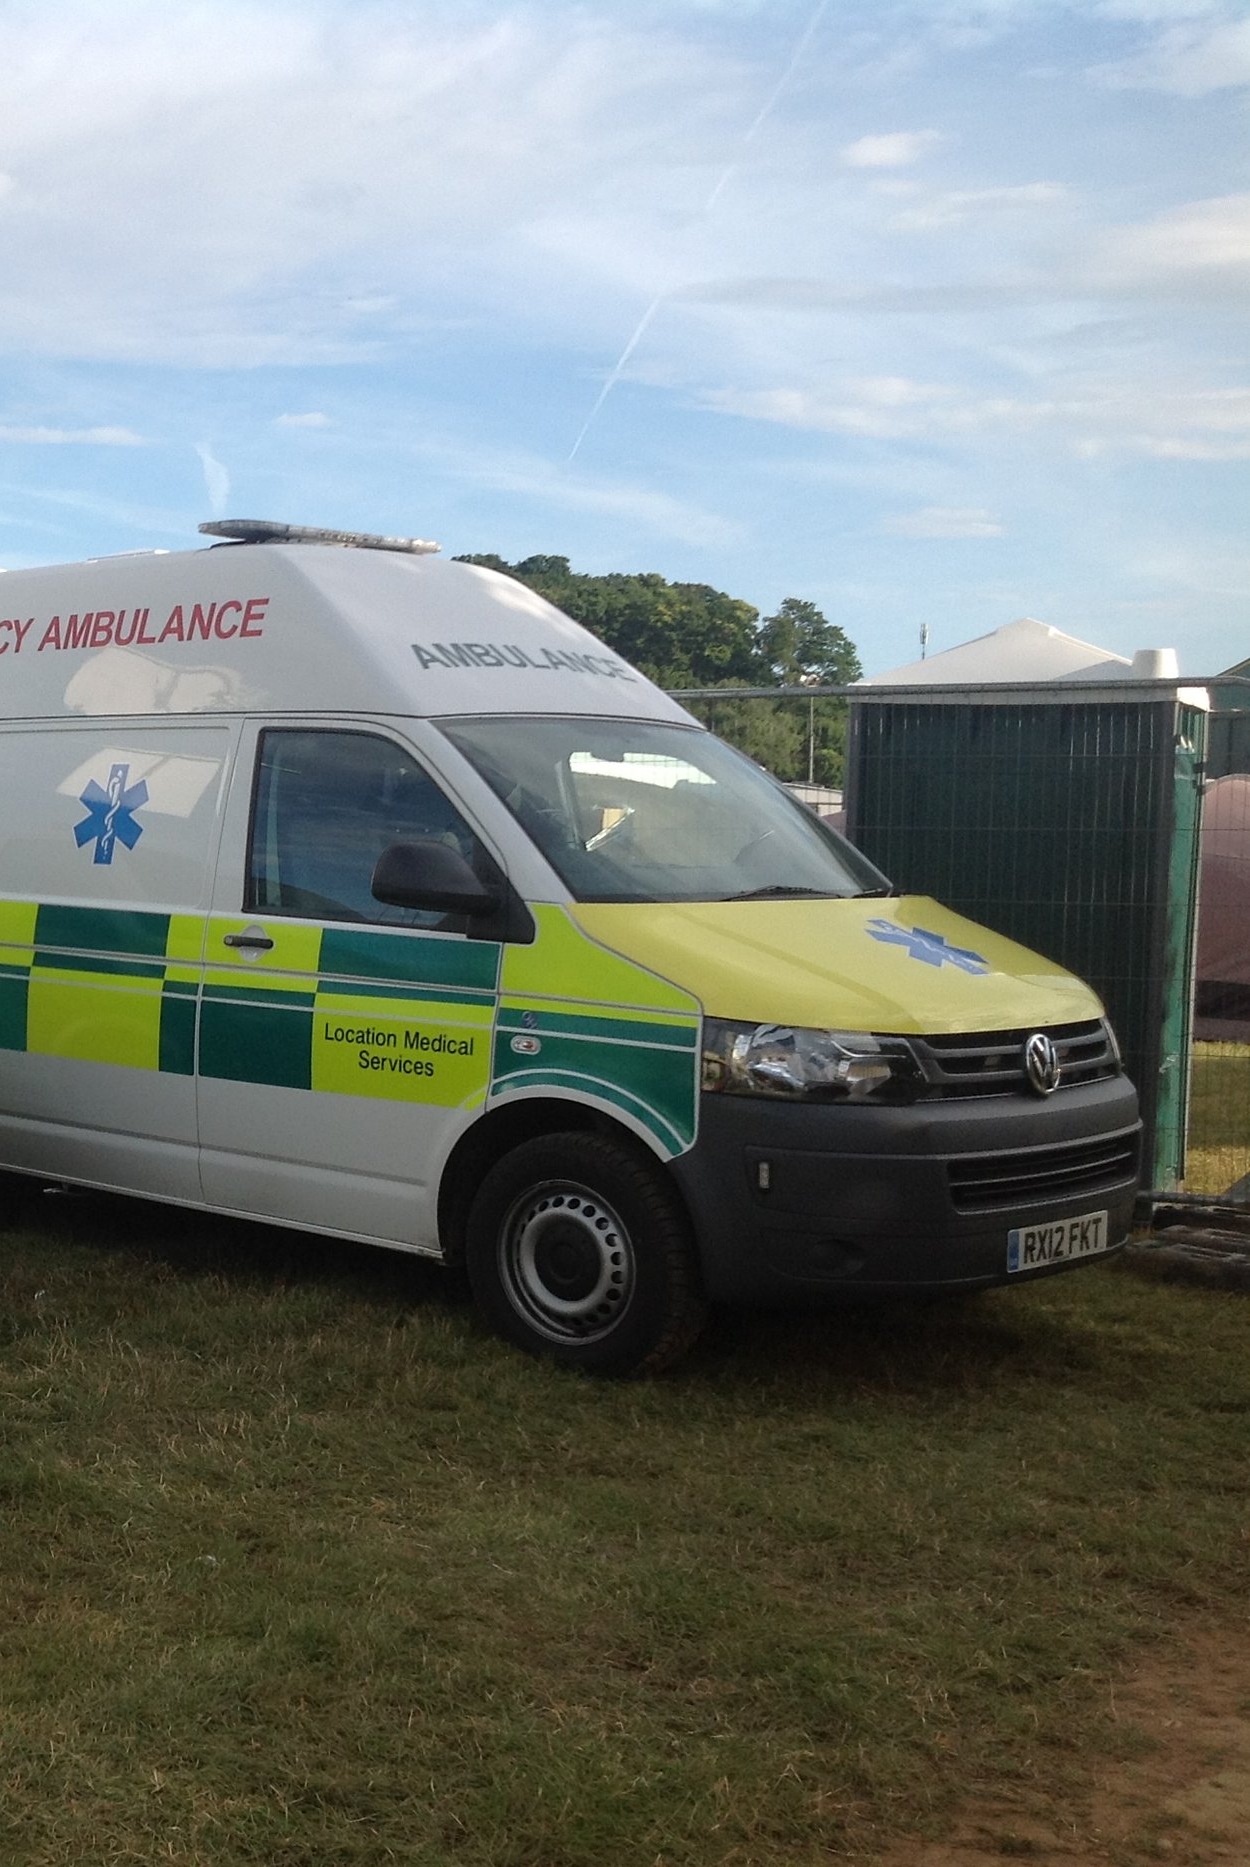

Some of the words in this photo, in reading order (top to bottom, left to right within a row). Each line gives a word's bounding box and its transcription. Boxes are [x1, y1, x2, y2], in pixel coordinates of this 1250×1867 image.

[37, 597, 270, 652] AMBULANCE
[410, 642, 639, 684] AMBULANCE
[324, 1022, 397, 1048] Location
[404, 1030, 474, 1056] Medical
[358, 1049, 435, 1077] Services
[1023, 1225, 1066, 1264] RX12
[1069, 1217, 1103, 1255] FKT
